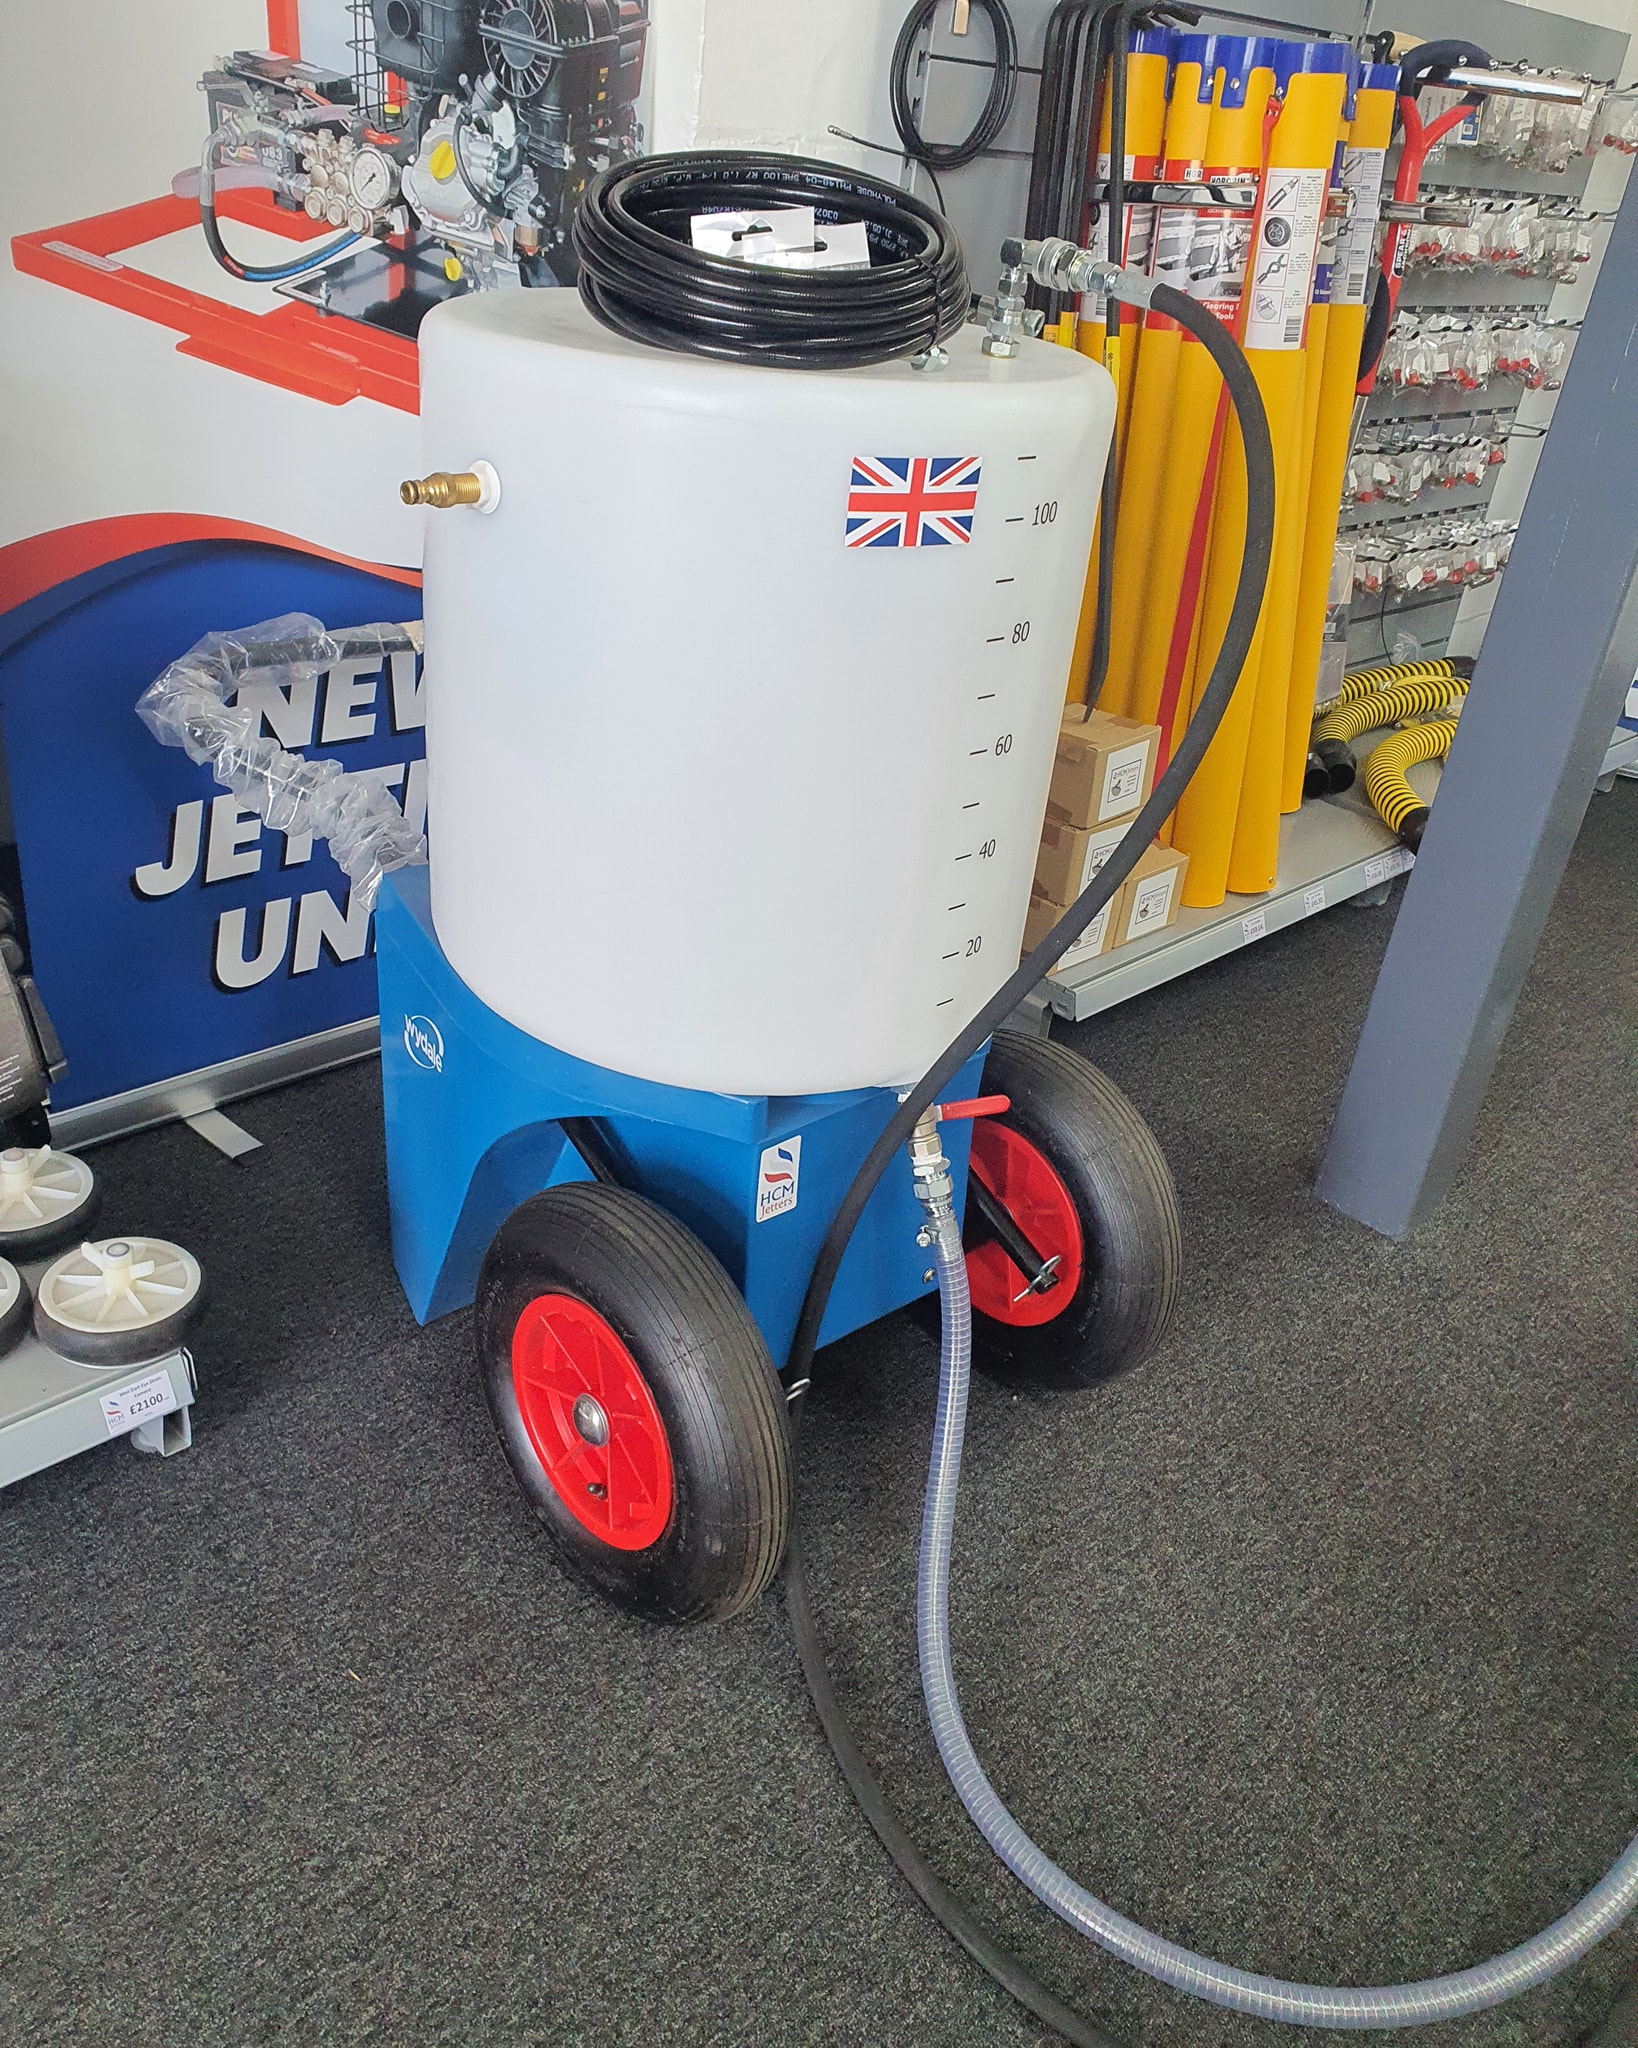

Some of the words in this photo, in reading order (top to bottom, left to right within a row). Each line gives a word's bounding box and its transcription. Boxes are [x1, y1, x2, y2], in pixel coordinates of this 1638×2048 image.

[1031, 501, 1058, 527] 100
[1011, 621, 1030, 644] 80
[994, 733, 1013, 757] 60
[979, 838, 997, 861] 40
[965, 935, 982, 958] 20
[404, 1013, 443, 1073] wydale
[760, 1181, 795, 1207] HCM
[760, 1197, 793, 1219] Jetters
[129, 1393, 164, 1415] £2100
